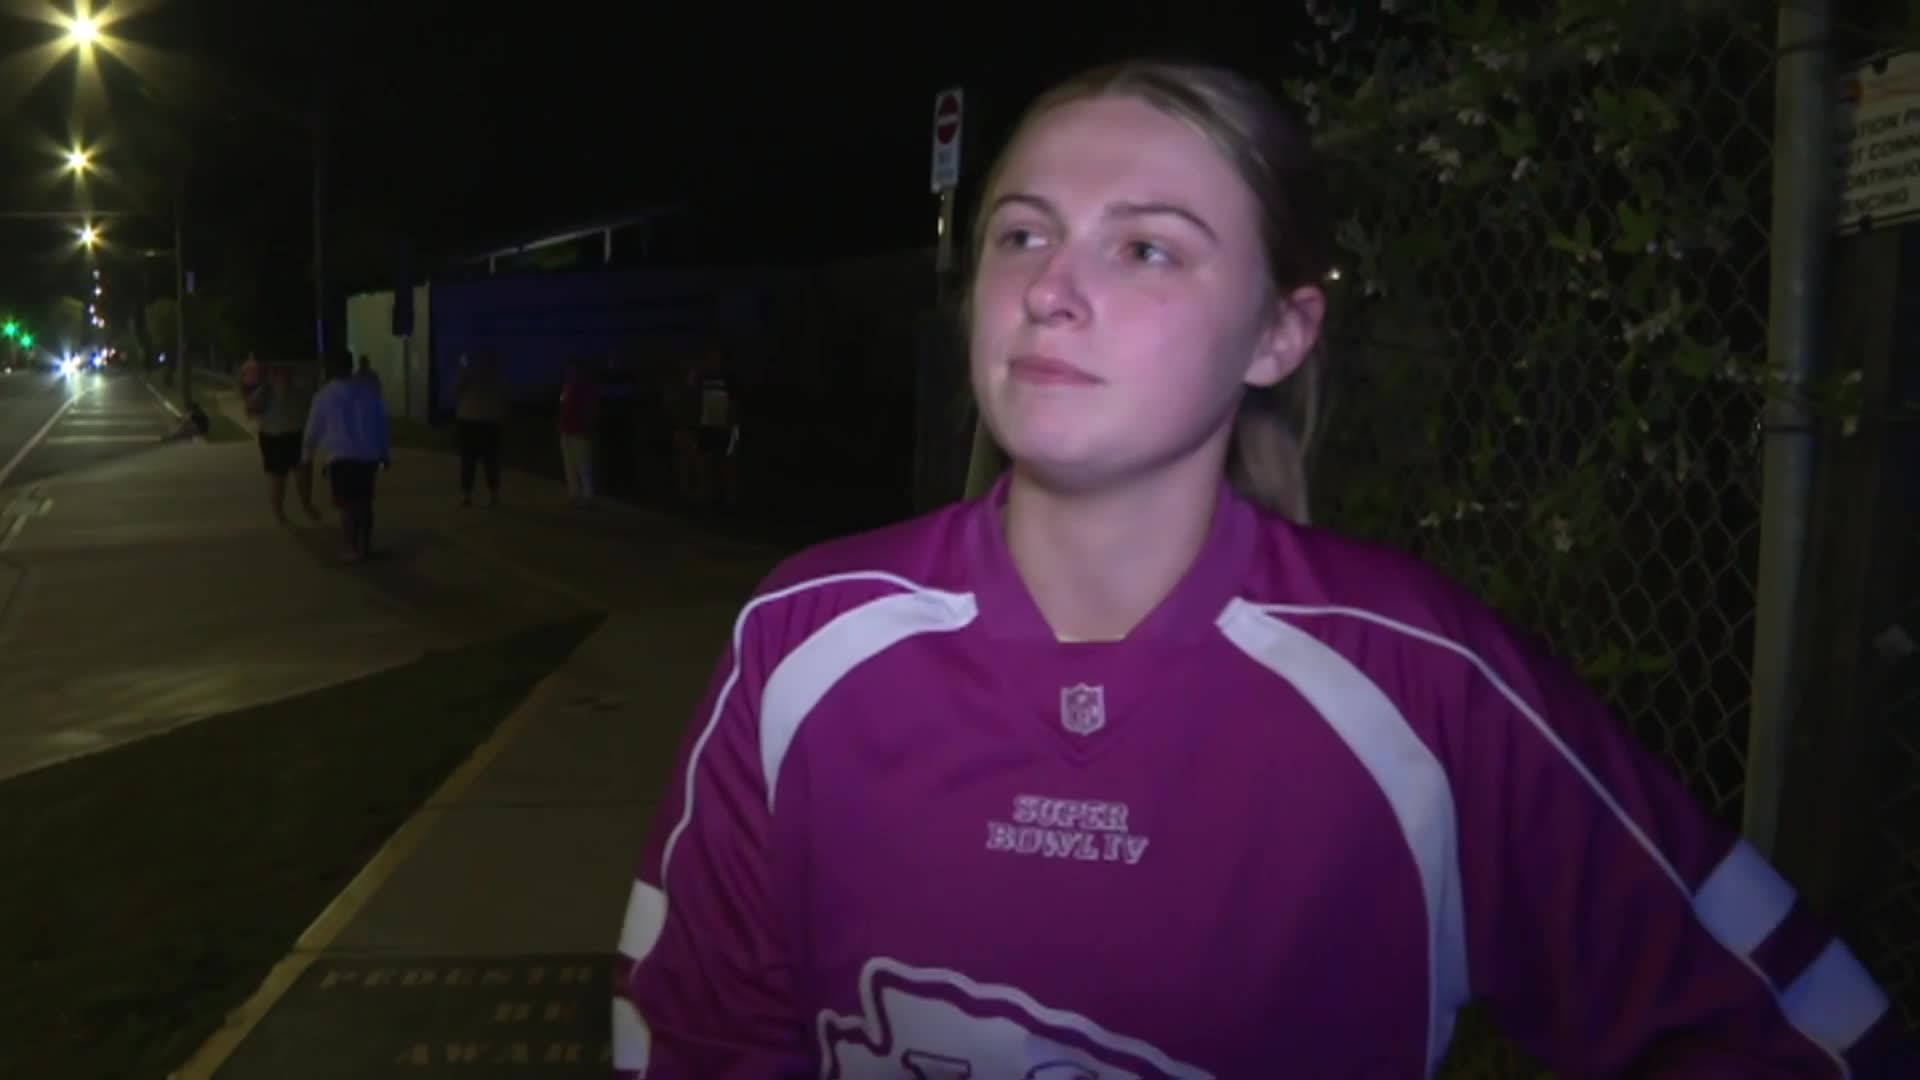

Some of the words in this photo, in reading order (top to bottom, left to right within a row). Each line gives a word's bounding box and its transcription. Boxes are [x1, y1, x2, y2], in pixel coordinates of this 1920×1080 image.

[1013, 796, 1128, 832] SUPER
[986, 821, 1099, 861] BOWL
[1103, 833, 1149, 865] IV
